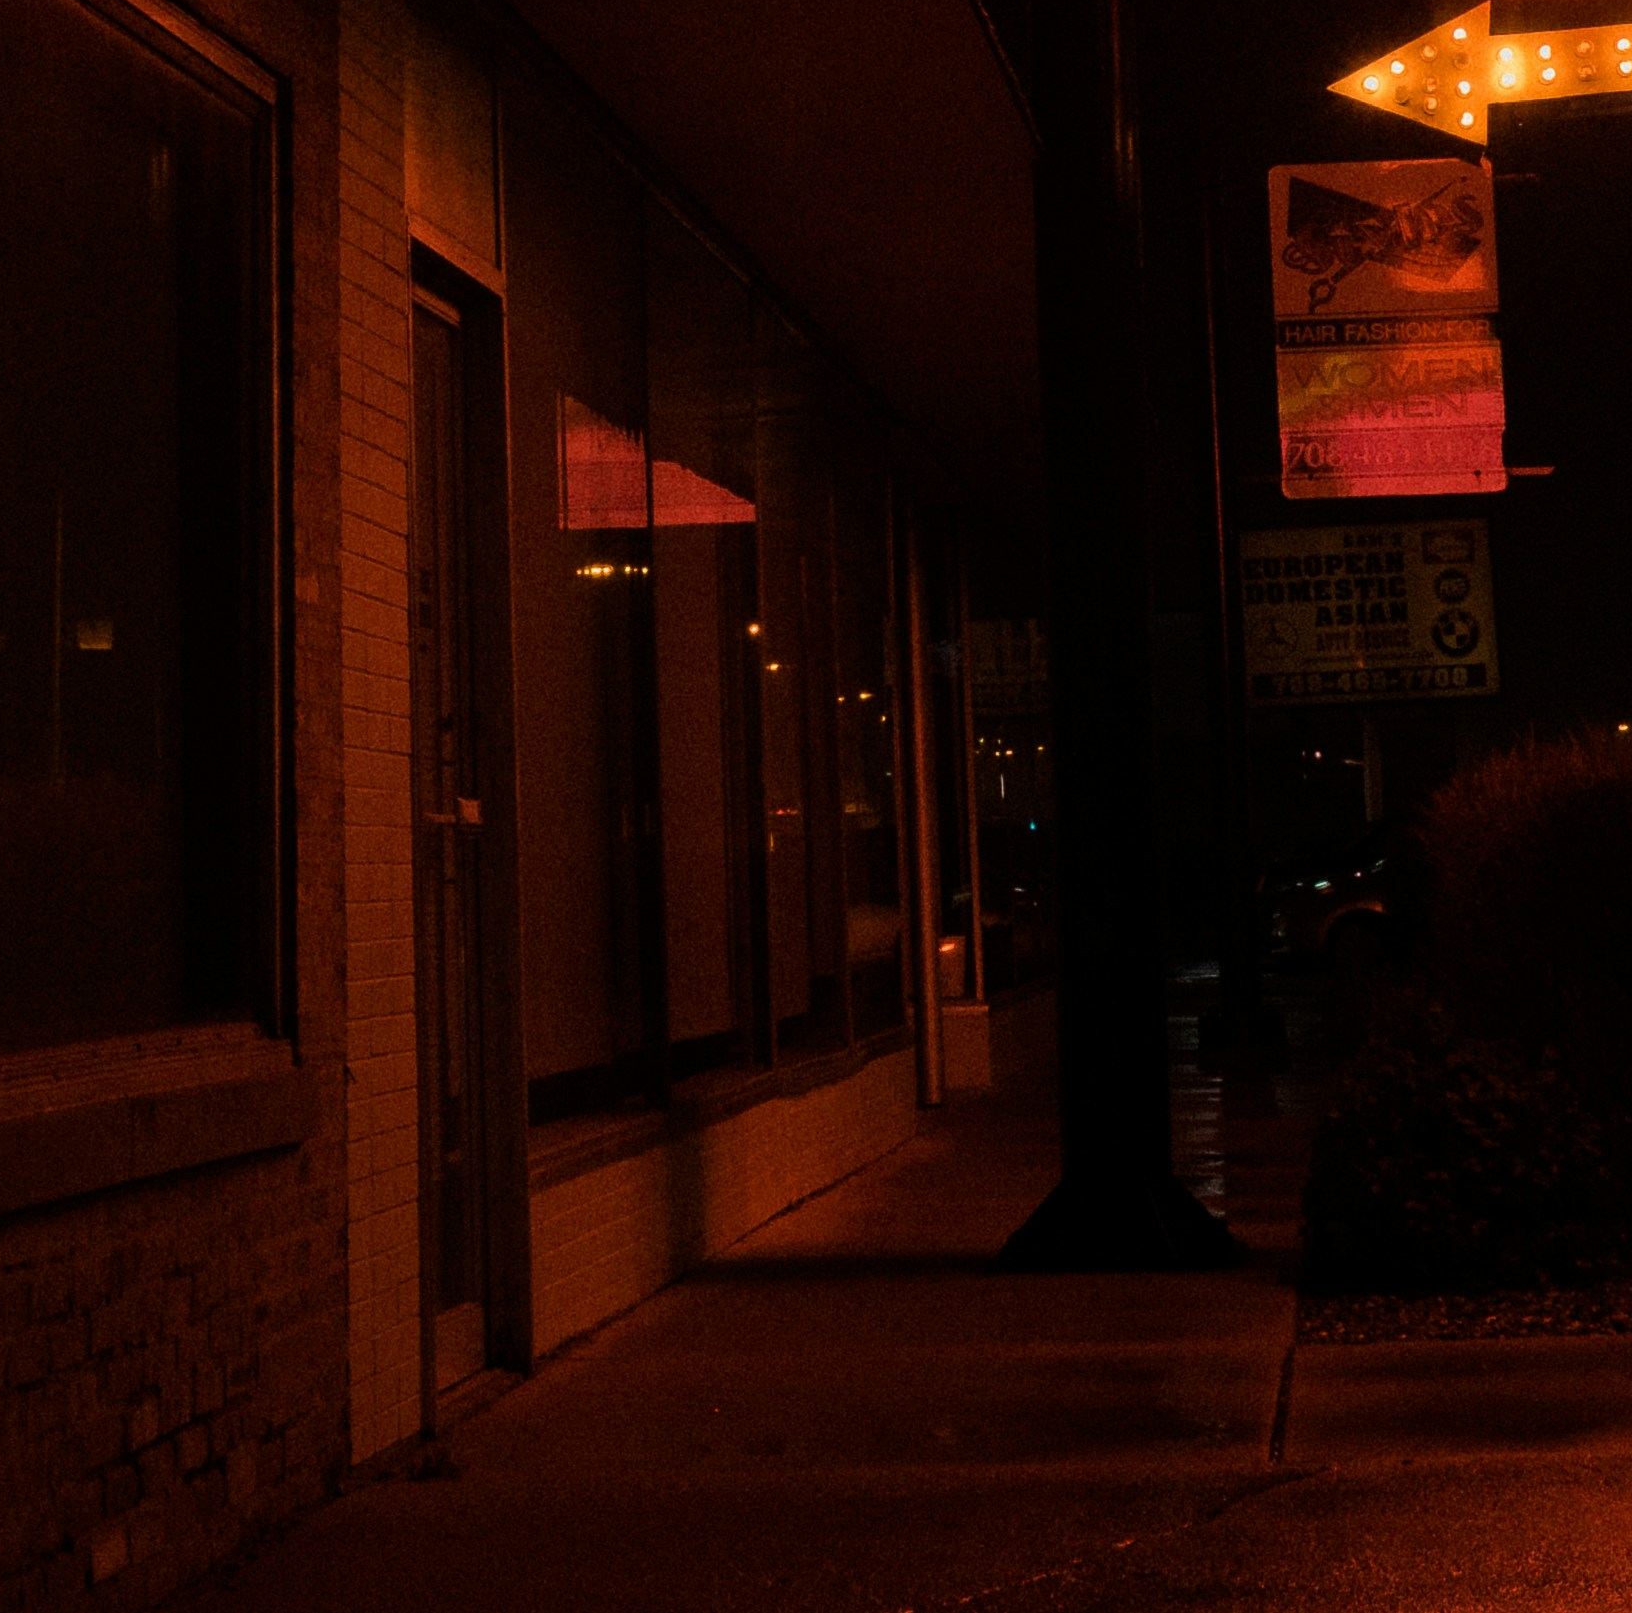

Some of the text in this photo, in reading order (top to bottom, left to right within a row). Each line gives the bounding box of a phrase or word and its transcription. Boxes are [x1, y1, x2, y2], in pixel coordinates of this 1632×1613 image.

[1284, 319, 1492, 344] HAIR FASHION FOR
[1291, 357, 1491, 390] WOMEN
[1358, 391, 1469, 421] MEN
[1244, 552, 1405, 579] EUROPEAN
[1245, 576, 1408, 604] DOMESTIC
[1315, 601, 1409, 628] ASIAN
